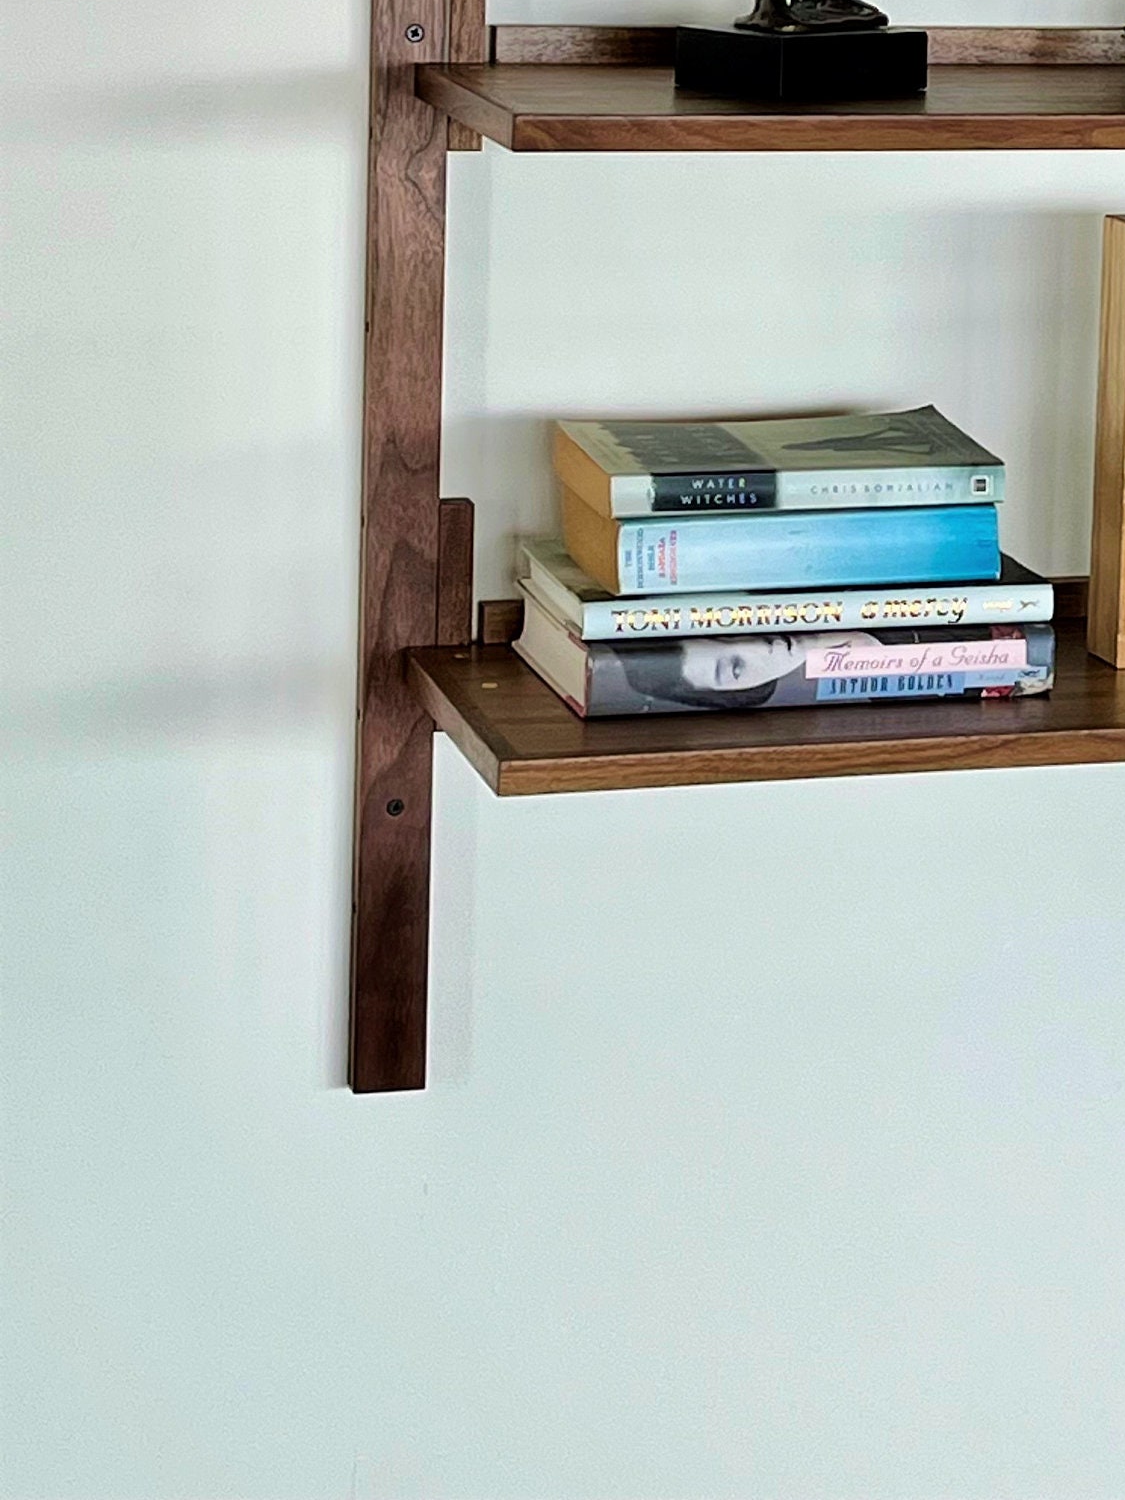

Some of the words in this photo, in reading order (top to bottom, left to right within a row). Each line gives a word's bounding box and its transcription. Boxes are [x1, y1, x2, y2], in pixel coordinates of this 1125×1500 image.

[691, 477, 746, 490] WATER
[810, 484, 858, 496] CHRIS
[680, 493, 759, 505] WITCHES
[611, 608, 681, 633] TONI
[689, 601, 844, 630] MORRISON
[860, 602, 877, 619] a
[883, 596, 968, 624] mercy
[823, 651, 903, 671] Memoirs
[909, 647, 931, 671] of
[932, 655, 943, 666] a
[951, 643, 1009, 665] Geisha
[831, 677, 889, 694] ARTHUR
[898, 673, 953, 690] GOLDEN
